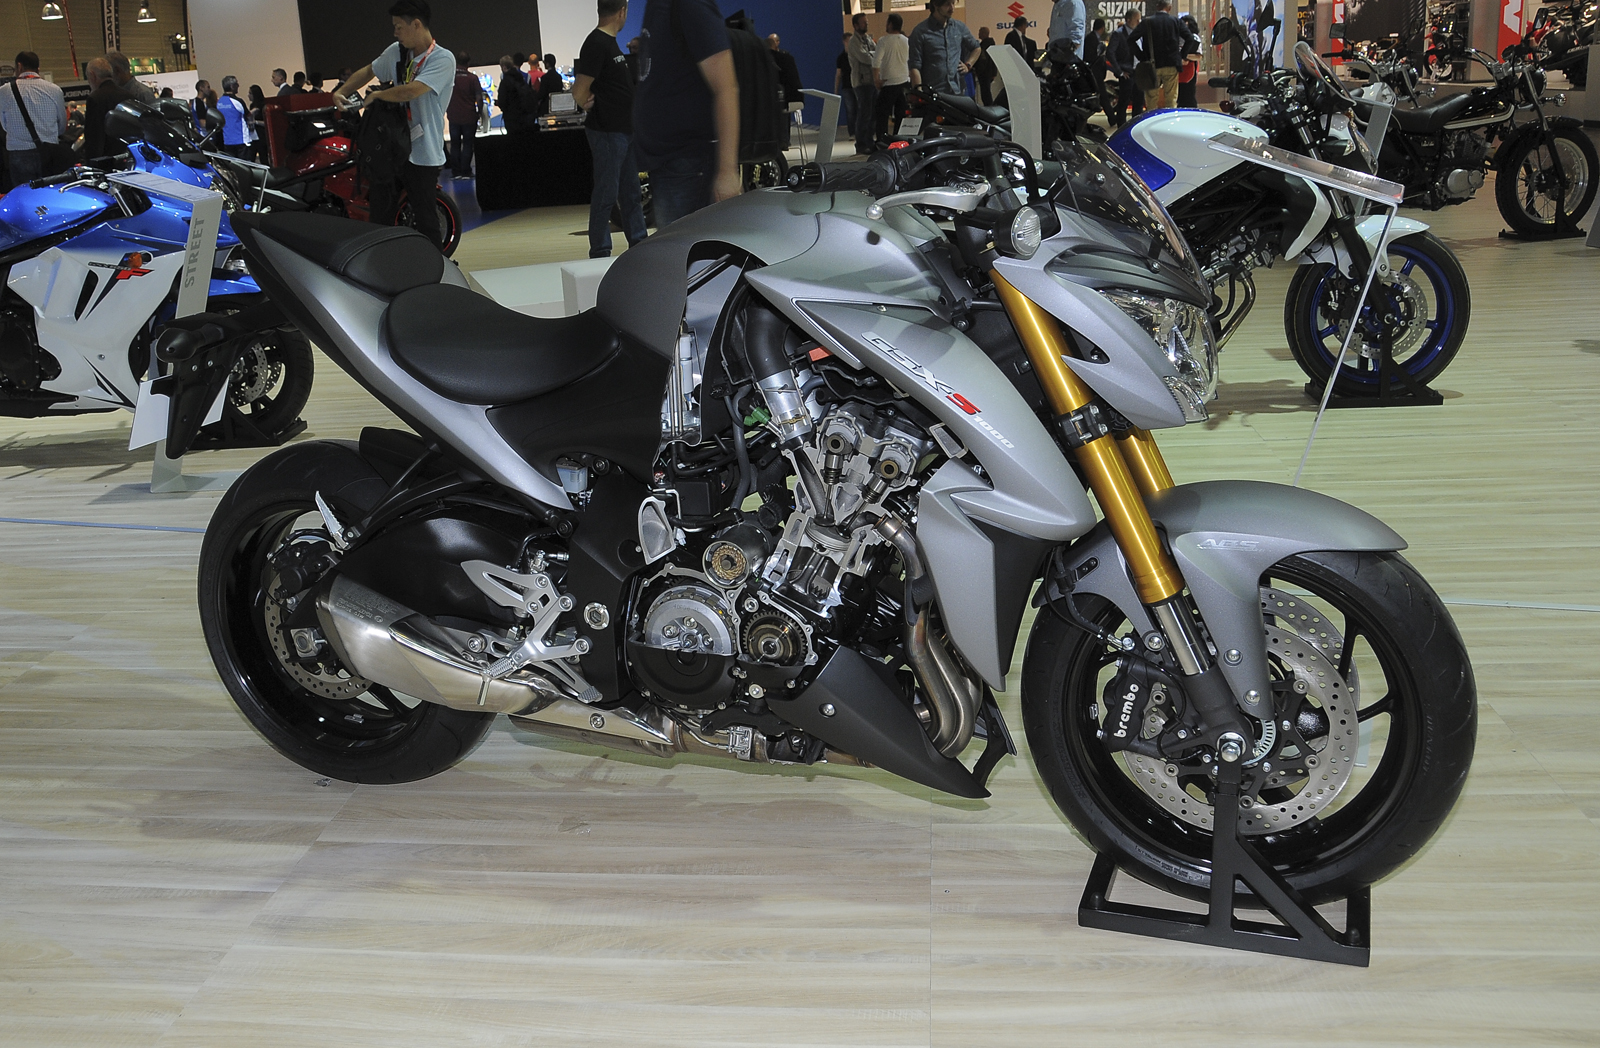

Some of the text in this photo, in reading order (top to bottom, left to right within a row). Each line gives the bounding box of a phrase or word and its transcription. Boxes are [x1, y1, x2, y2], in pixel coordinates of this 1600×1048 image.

[996, 20, 1037, 30] SUKI
[184, 217, 205, 288] STREET
[974, 415, 1015, 449] 1000
[1197, 538, 1260, 552] ABS
[1113, 683, 1139, 738] brembo
